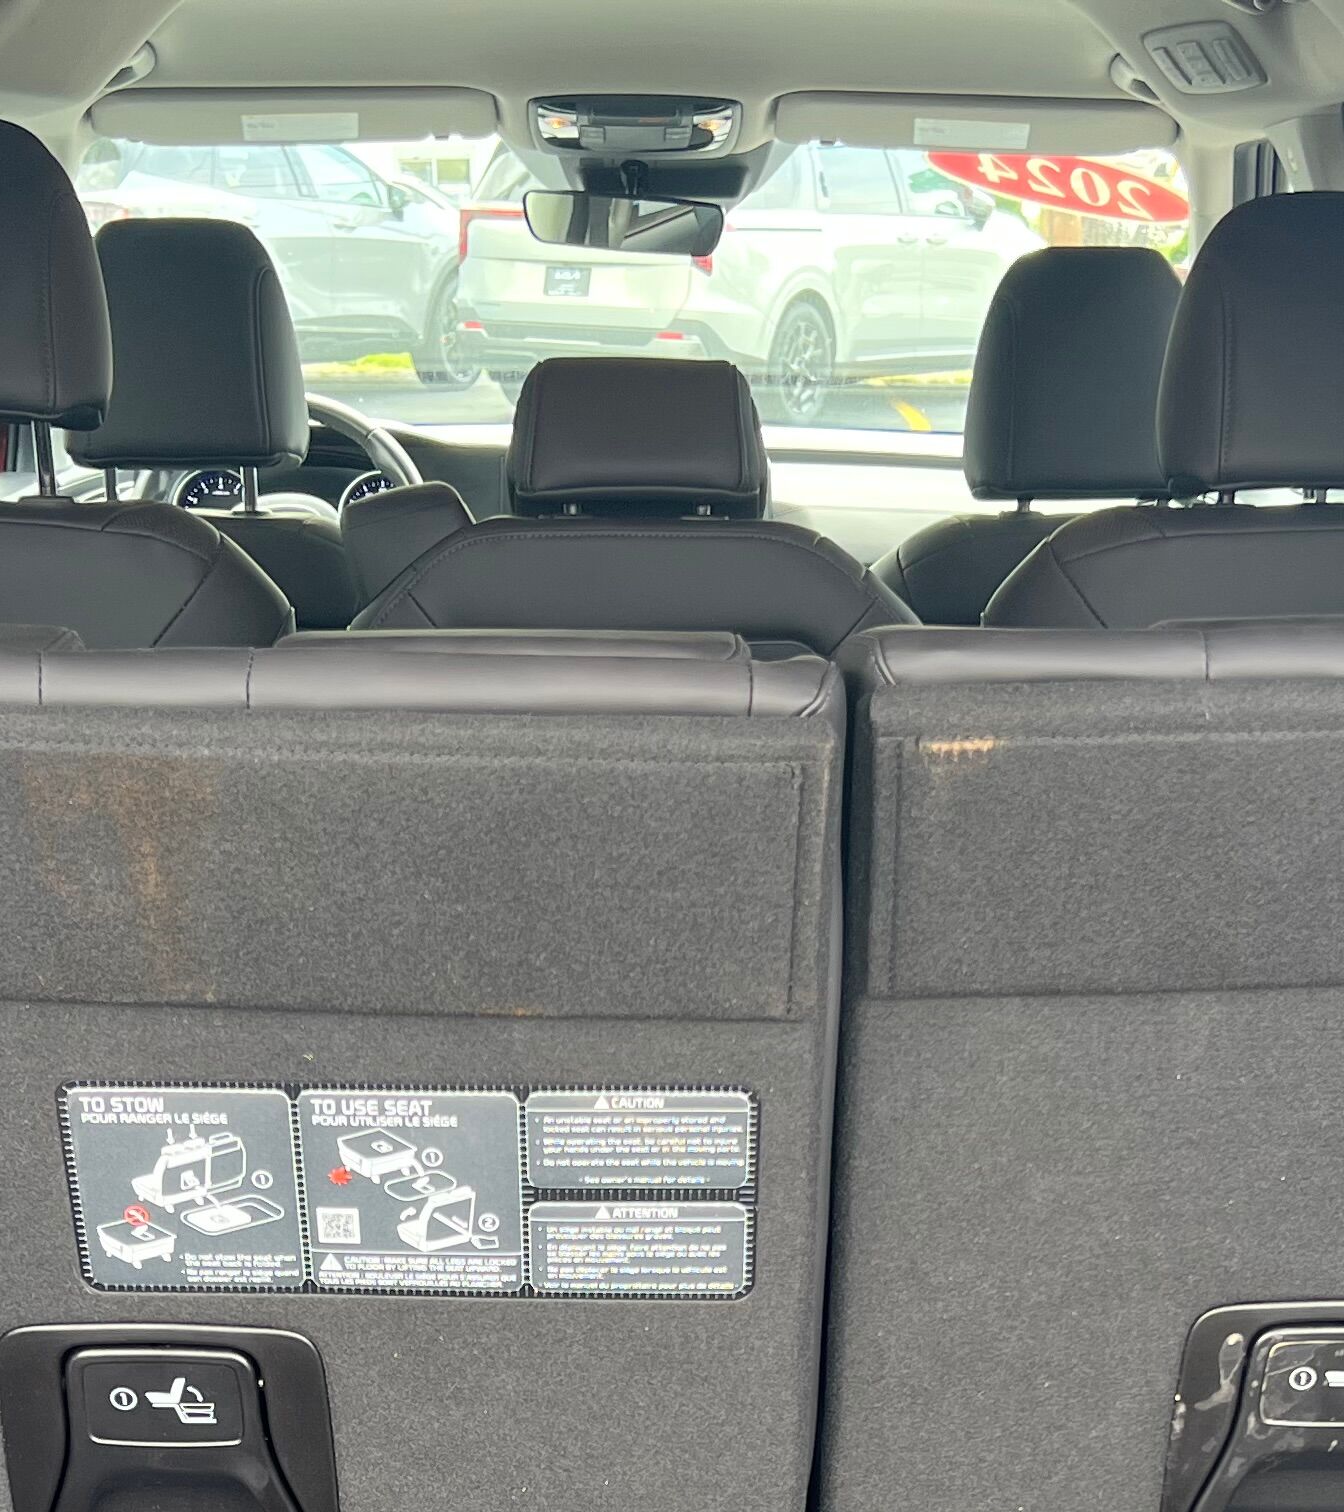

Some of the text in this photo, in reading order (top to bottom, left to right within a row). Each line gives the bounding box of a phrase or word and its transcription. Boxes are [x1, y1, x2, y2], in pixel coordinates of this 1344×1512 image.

[79, 1097, 164, 1113] TO STOW
[310, 1099, 433, 1116] TO USE SEAT
[611, 1098, 665, 1109] CAUTION
[80, 1113, 118, 1123] POUR
[120, 1113, 172, 1124] RANGER
[174, 1114, 190, 1124] LE
[312, 1115, 347, 1126] POUR
[350, 1116, 403, 1127] UTILISER
[405, 1116, 421, 1127] LE
[663, 1175, 677, 1184] for
[613, 1208, 679, 1219] ATTENTION
